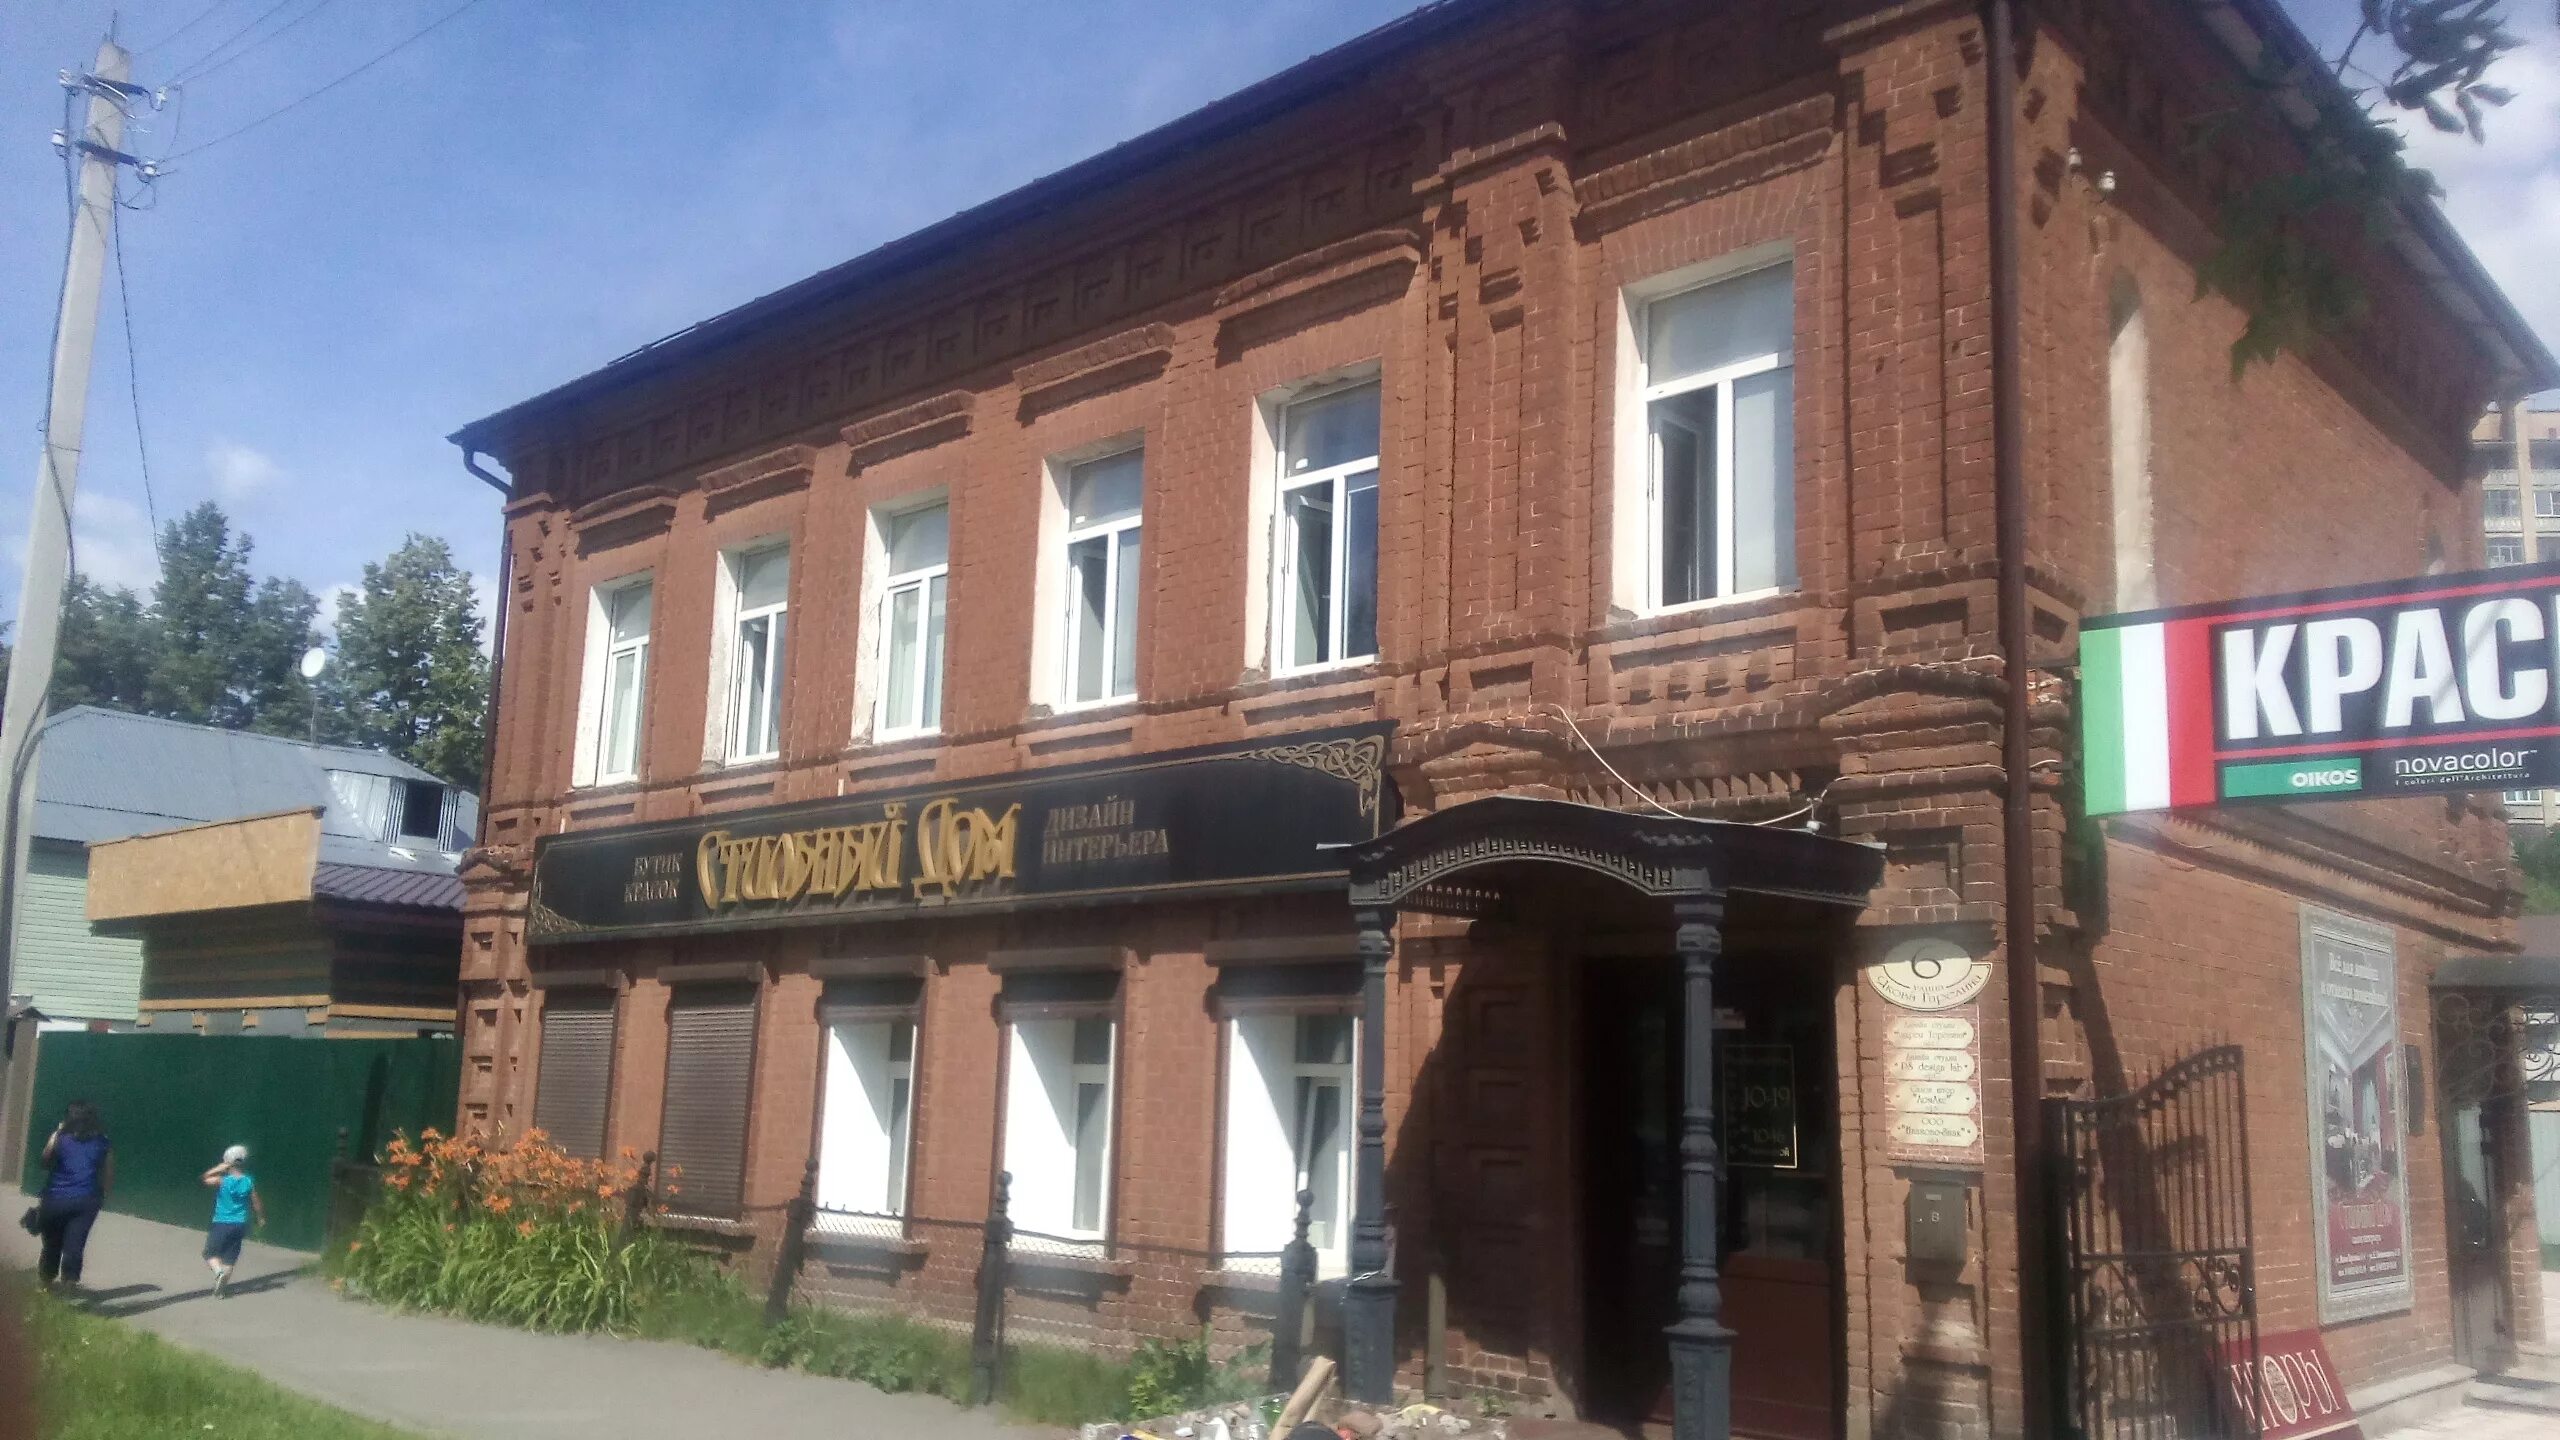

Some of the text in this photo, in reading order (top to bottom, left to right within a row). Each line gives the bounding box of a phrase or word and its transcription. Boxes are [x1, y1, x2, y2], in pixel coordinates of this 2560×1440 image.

[2224, 595, 2560, 739] КРАС
[2291, 769, 2358, 788] OIKOS
[1044, 795, 1135, 835] ДИЗАЙН
[1043, 829, 1169, 864] ИНТЕРЬЕРА
[634, 852, 683, 877] БУТИК
[624, 878, 680, 903] КРАСОК
[1911, 945, 1942, 979] 6
